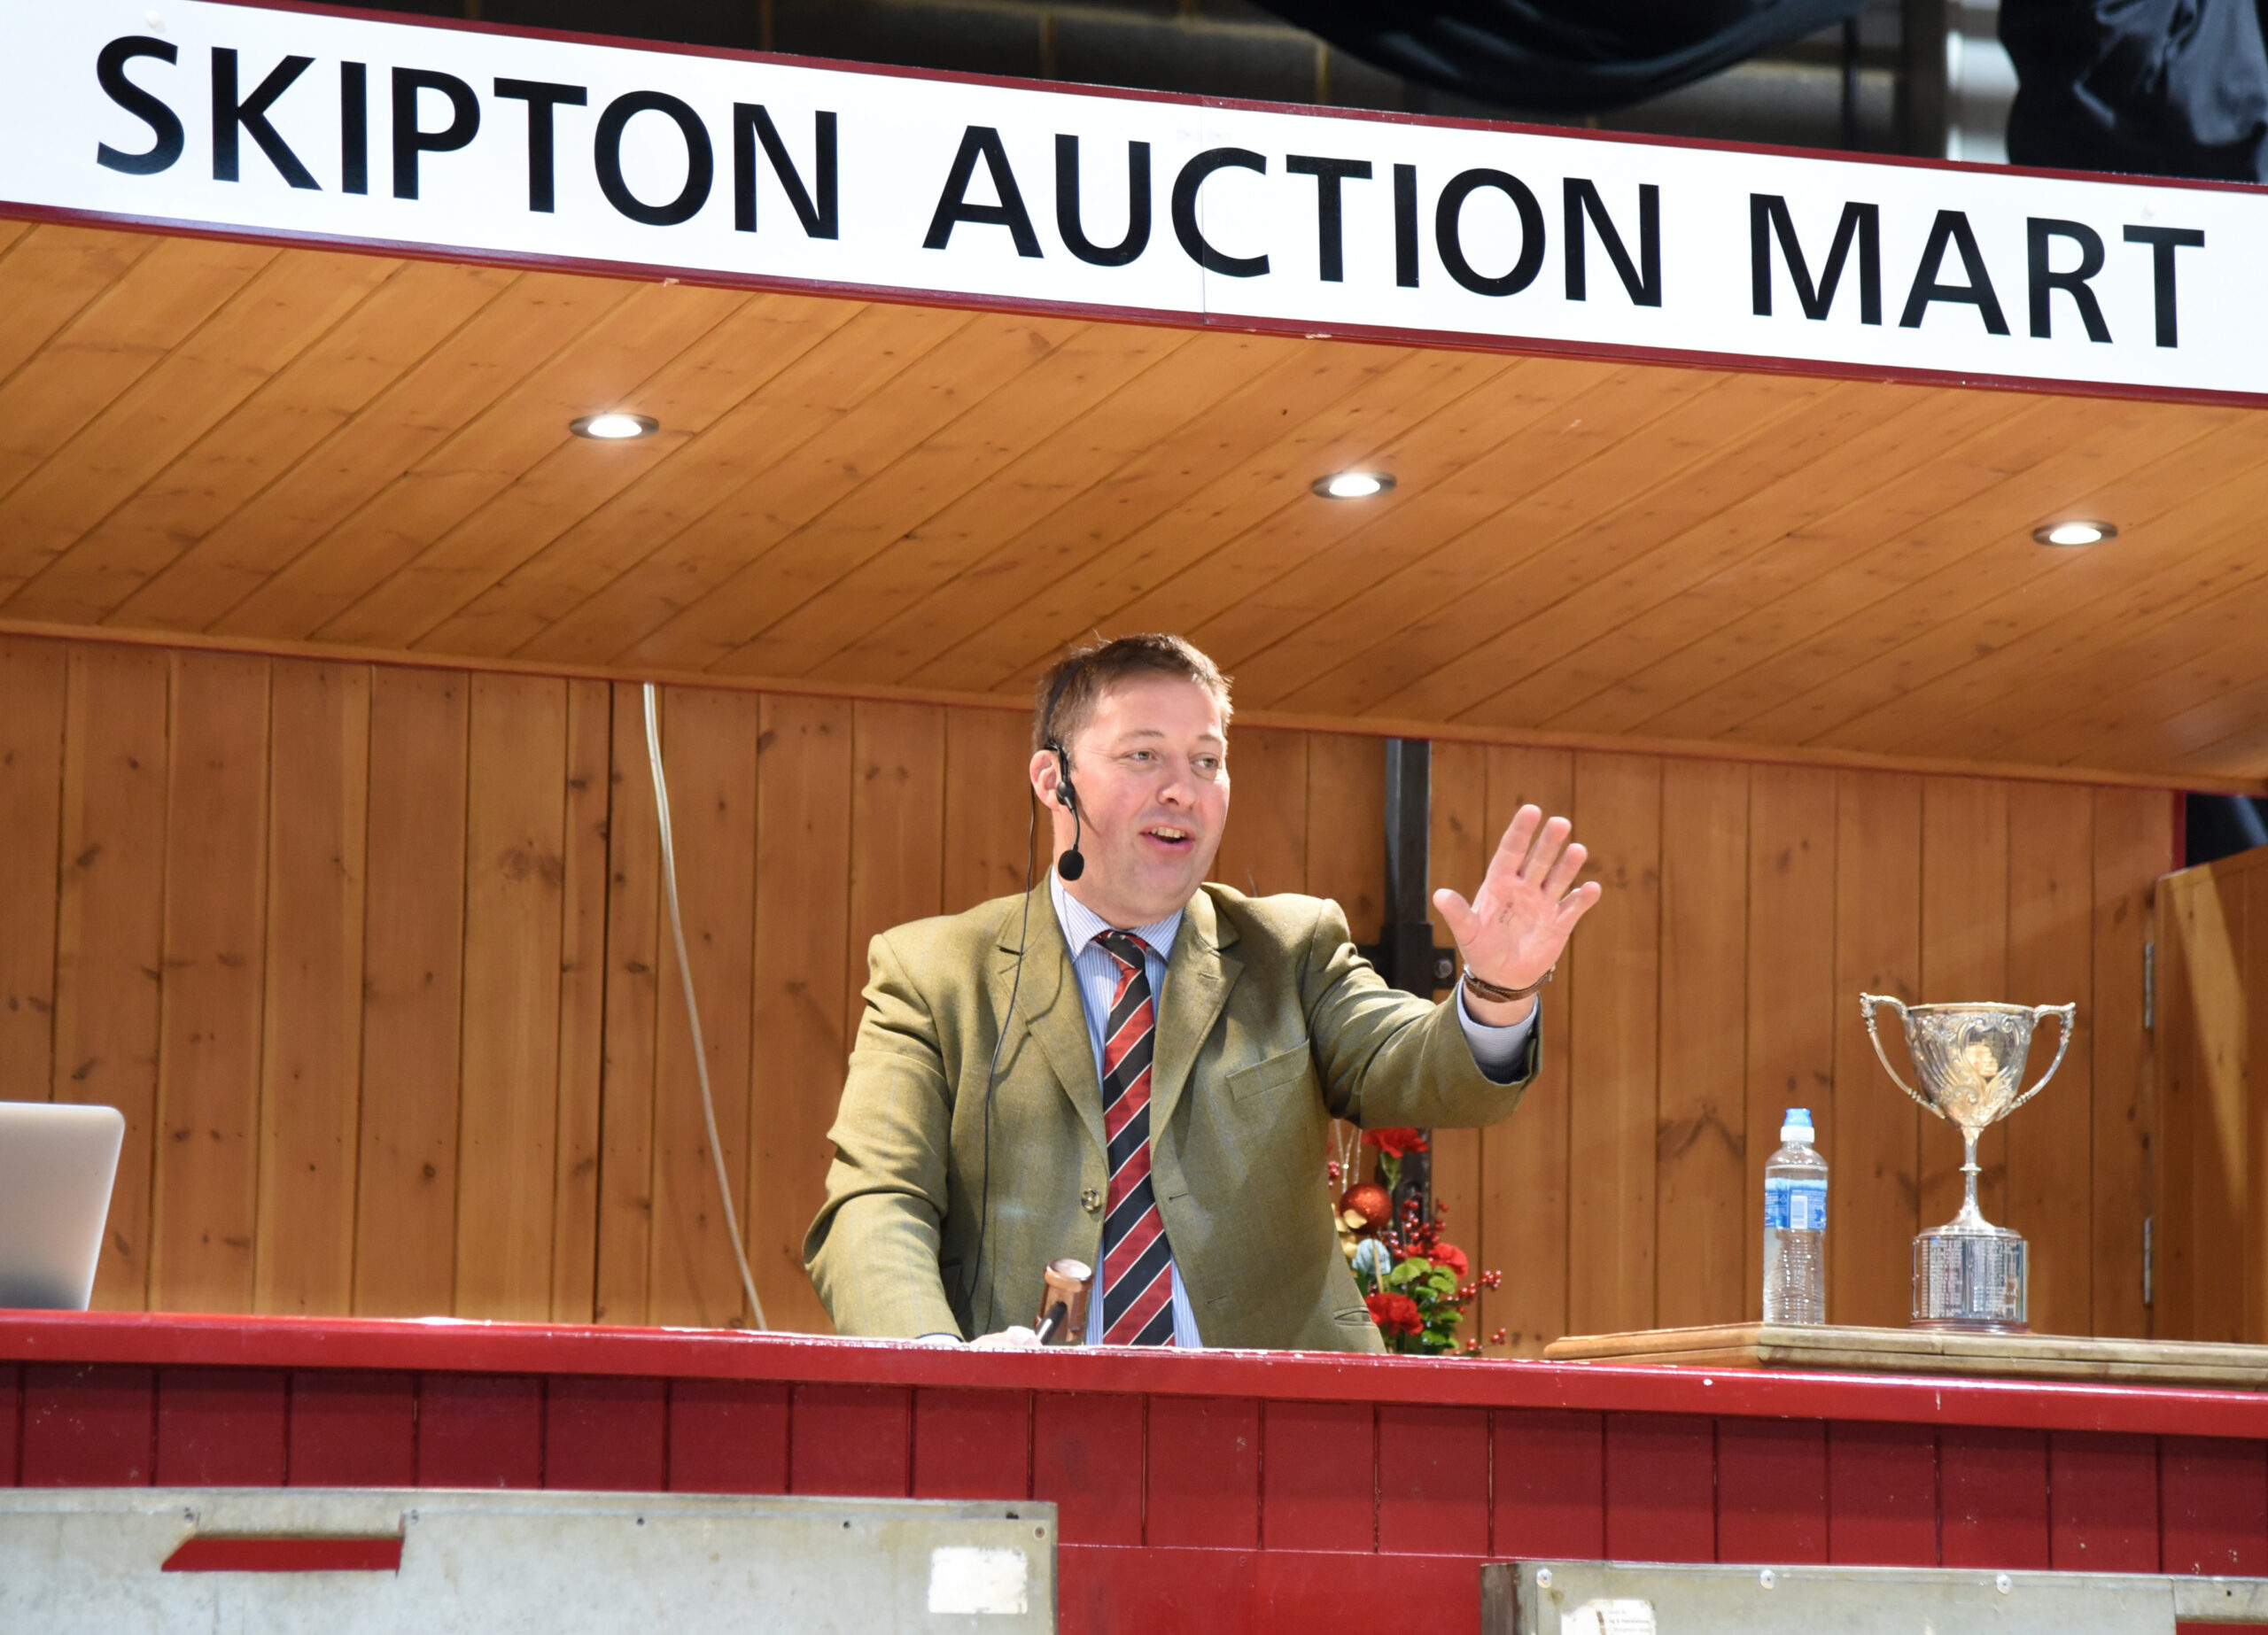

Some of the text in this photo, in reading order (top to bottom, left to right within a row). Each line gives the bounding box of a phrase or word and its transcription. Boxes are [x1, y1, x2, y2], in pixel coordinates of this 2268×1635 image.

[97, 35, 2205, 348] SKIPTON AUCTION MART
